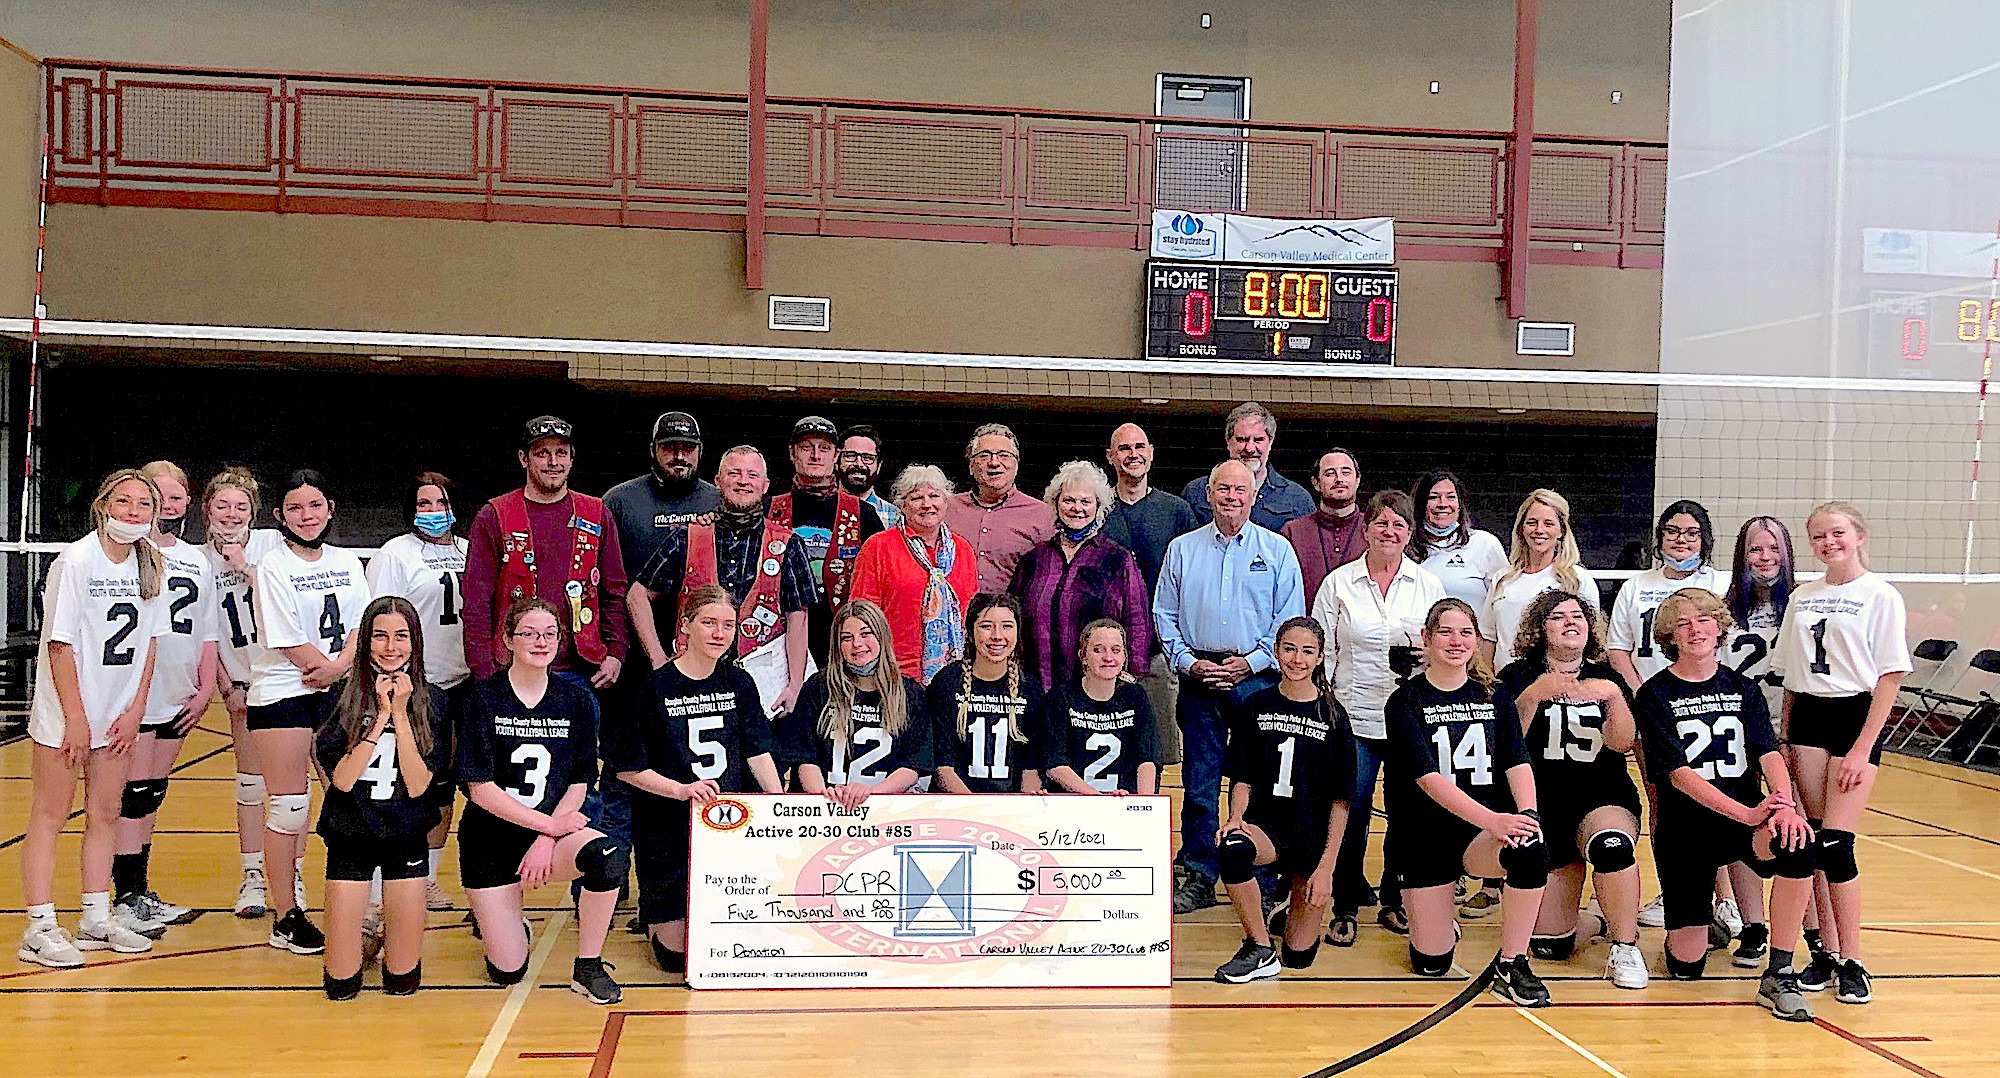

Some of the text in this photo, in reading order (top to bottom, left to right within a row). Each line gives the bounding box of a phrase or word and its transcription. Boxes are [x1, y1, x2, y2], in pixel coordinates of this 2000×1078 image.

[1162, 236, 1210, 246] stay hydrated
[1241, 249, 1388, 262] Carson Valley Medical Center
[1154, 271, 1208, 289] HOME
[1335, 277, 1394, 296] GUEST
[1244, 272, 1327, 318] 8:00
[1184, 290, 1210, 336] 0
[1367, 298, 1391, 342] 0
[1254, 320, 1289, 330] PERIOD
[1179, 345, 1217, 356] BONUS
[1324, 349, 1362, 360] BONUS
[168, 576, 198, 634] 2
[319, 593, 346, 653] 4
[103, 603, 138, 665] 2
[1810, 618, 1830, 675] 1
[851, 712, 880, 722] OLLEYBALL
[1006, 705, 1025, 714] LGUE
[1544, 704, 1604, 762] 15
[688, 715, 727, 780] 5
[827, 727, 892, 786] 12
[968, 717, 1009, 778] 11
[1432, 723, 1493, 786] 14
[1676, 716, 1748, 780] 23
[358, 732, 398, 800] 4
[1084, 733, 1121, 792] 2
[1273, 737, 1295, 798] 1
[505, 744, 551, 809] 3
[773, 802, 821, 817] Carson
[745, 825, 912, 838] Active 20-30 Club #85
[1038, 829, 1105, 846] 5/12/2021
[823, 823, 937, 869] ACTE
[991, 841, 1015, 850] Date
[705, 874, 756, 886] Pay to the
[725, 885, 770, 895] Order of
[822, 871, 897, 897] DCPR
[1017, 868, 1036, 892] $
[728, 904, 758, 920] Five
[765, 901, 834, 919] Thousand
[843, 904, 866, 918] and
[1103, 909, 1139, 920] Dollars
[710, 948, 727, 958] For
[733, 944, 785, 958] Donation
[1091, 943, 1125, 954] 20-30
